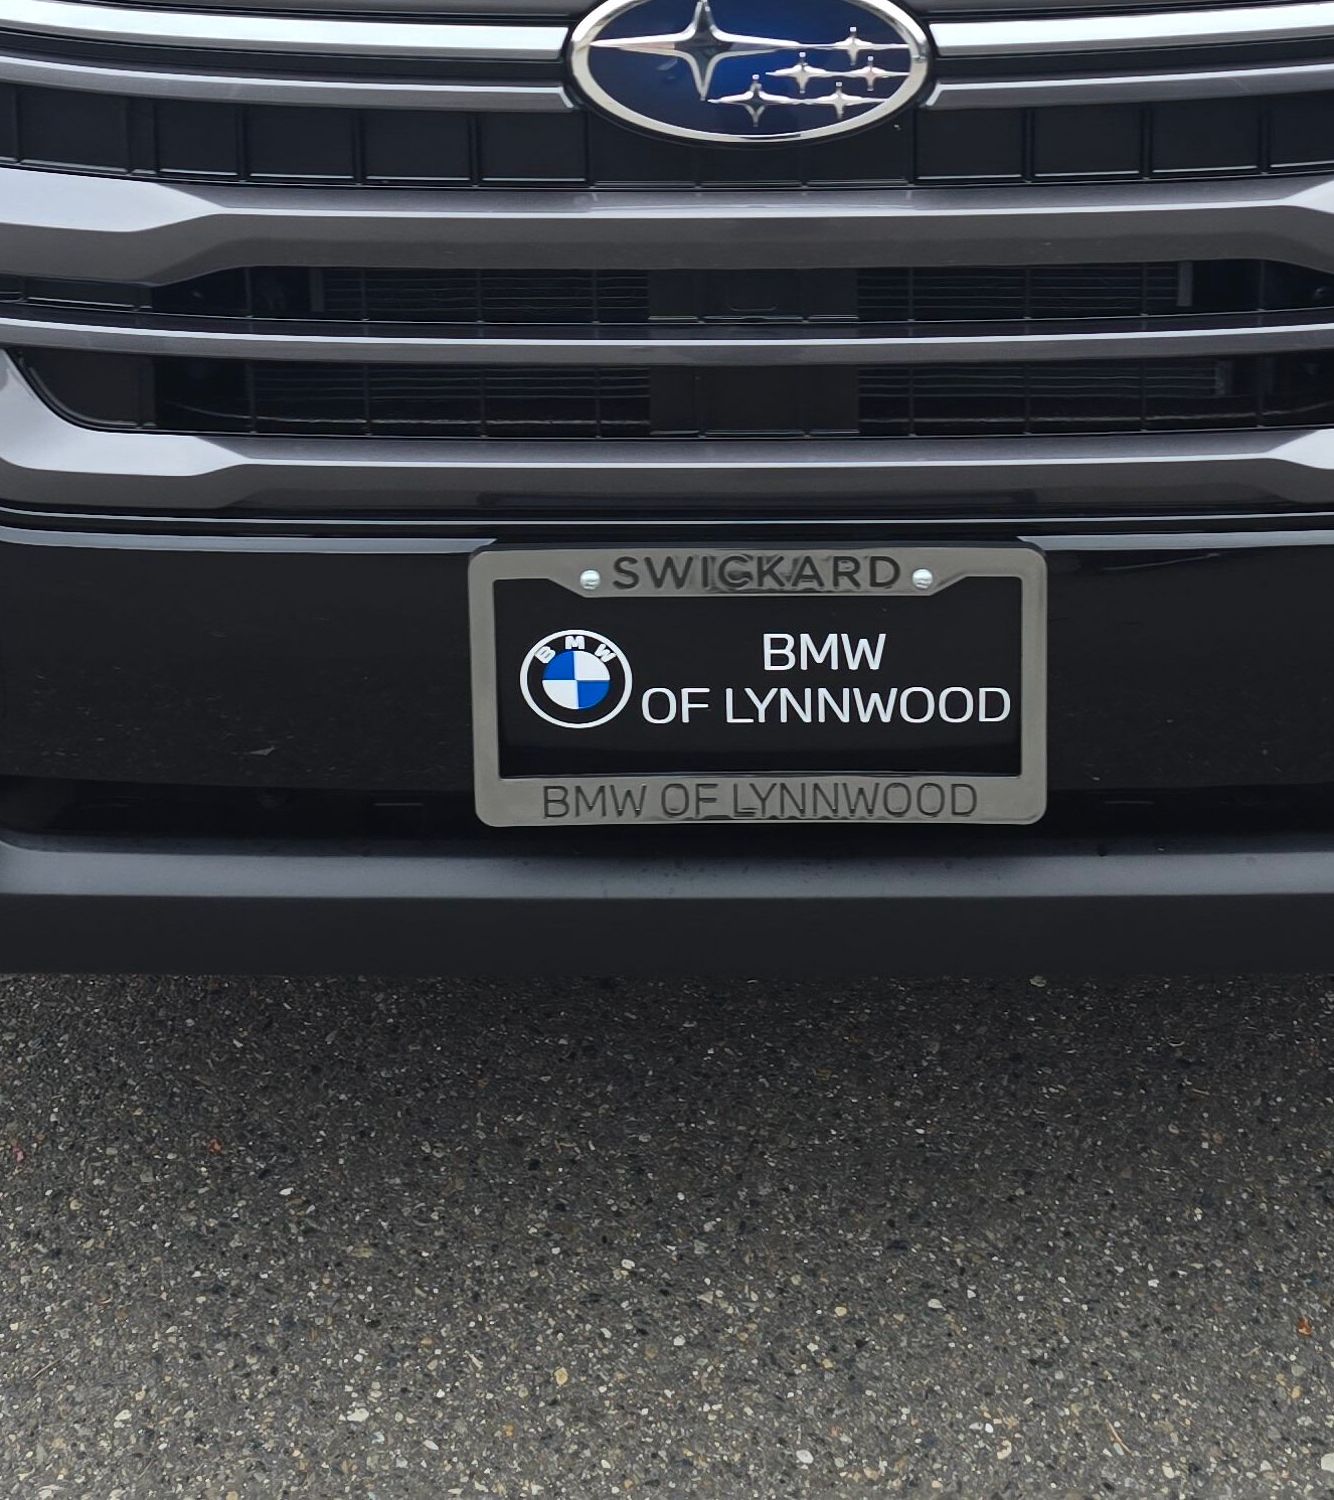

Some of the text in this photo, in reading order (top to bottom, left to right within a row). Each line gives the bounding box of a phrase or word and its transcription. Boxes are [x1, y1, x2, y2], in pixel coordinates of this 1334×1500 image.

[611, 554, 902, 591] SWICKARD
[534, 635, 617, 664] BMW
[762, 633, 886, 671] BMW
[641, 686, 1011, 724] OF LYNNWOOD
[543, 783, 978, 819] BMW OF LYNNWOOD
